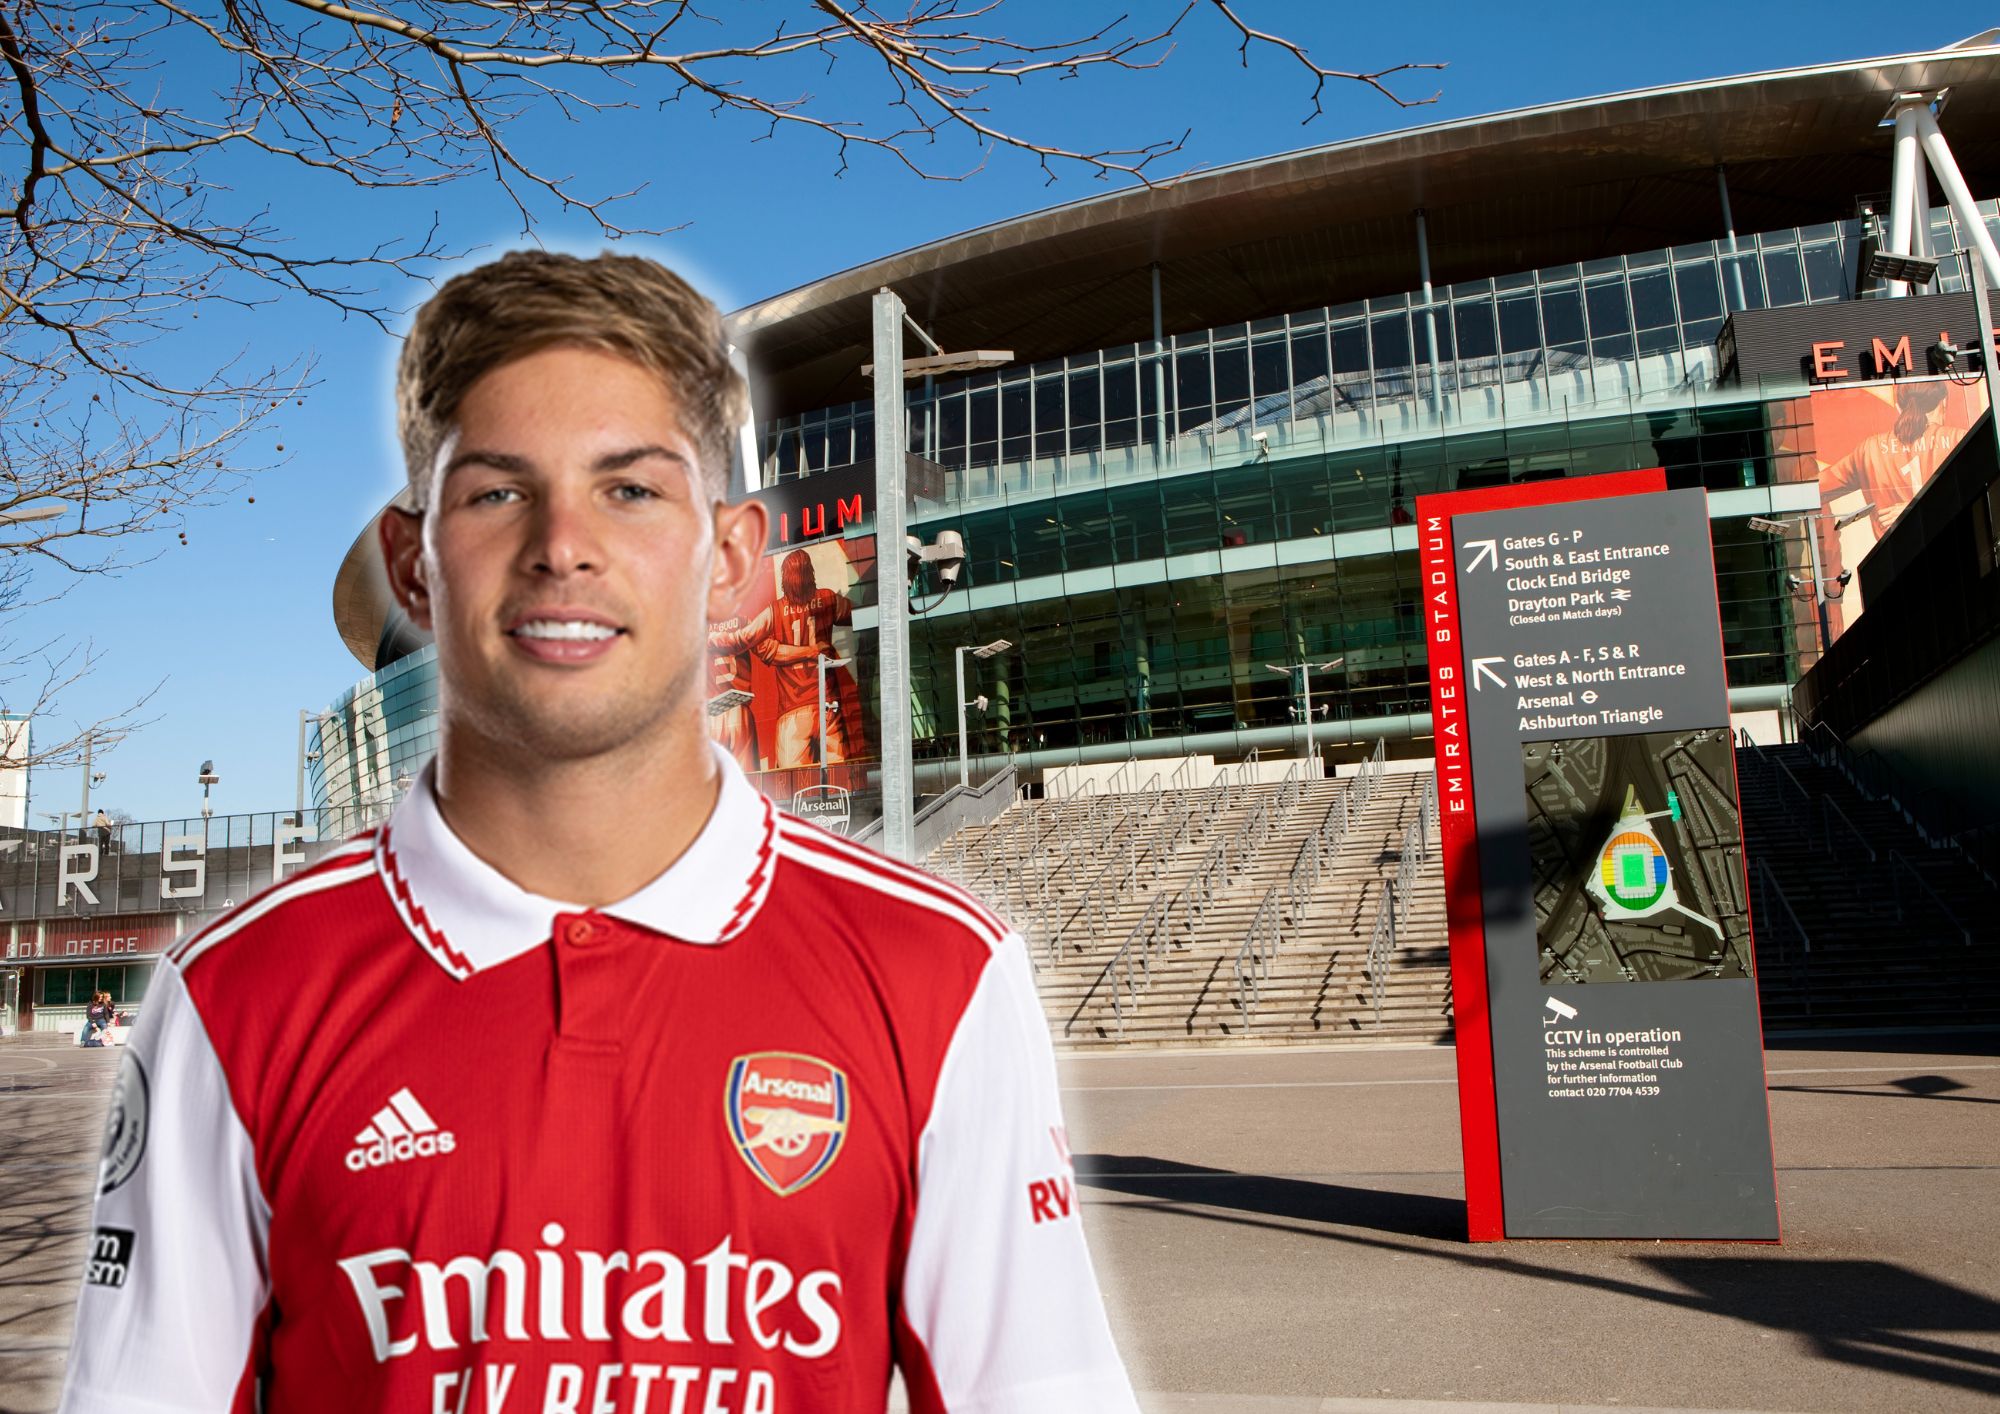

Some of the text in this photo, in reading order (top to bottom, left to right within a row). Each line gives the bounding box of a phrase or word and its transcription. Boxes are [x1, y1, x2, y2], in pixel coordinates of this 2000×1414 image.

[1812, 328, 2000, 379] EM
[1503, 537, 1545, 550] Gates
[1549, 533, 1559, 545] G
[1573, 530, 1583, 543] P
[1505, 555, 1548, 571] South
[1569, 550, 1600, 564] East
[1604, 544, 1670, 561] Entrance
[1507, 568, 1631, 591] Clock End Bridge
[1509, 590, 1605, 614] Drayton Park
[1510, 606, 1622, 626] (Closed on Match days)
[1427, 516, 1465, 812] EMIRATES STADIUM
[1514, 654, 1556, 667] Gates
[1560, 651, 1570, 663] A
[1584, 649, 1595, 663] F,
[1599, 647, 1609, 660] S
[1629, 645, 1639, 657] R
[1515, 674, 1552, 688] West
[1572, 668, 1614, 683] North
[1619, 664, 1685, 680] Entrance
[1517, 692, 1573, 709] Arsenal
[1519, 707, 1662, 730] Ashburton Triangle
[800, 799, 842, 813] Arsenal
[66, 937, 138, 956] OFFICE
[1545, 1028, 1681, 1047] CCTV in operation
[1545, 1046, 1669, 1058] This scheme is controlled
[1547, 1059, 1683, 1074] by the Arsenal Football Club
[743, 1071, 833, 1105] Arsenal
[1548, 1073, 1657, 1084] for further information
[1549, 1087, 1660, 1098] contact 020 7704 4539
[344, 1129, 456, 1172] adidas
[337, 1222, 842, 1363] Emirates
